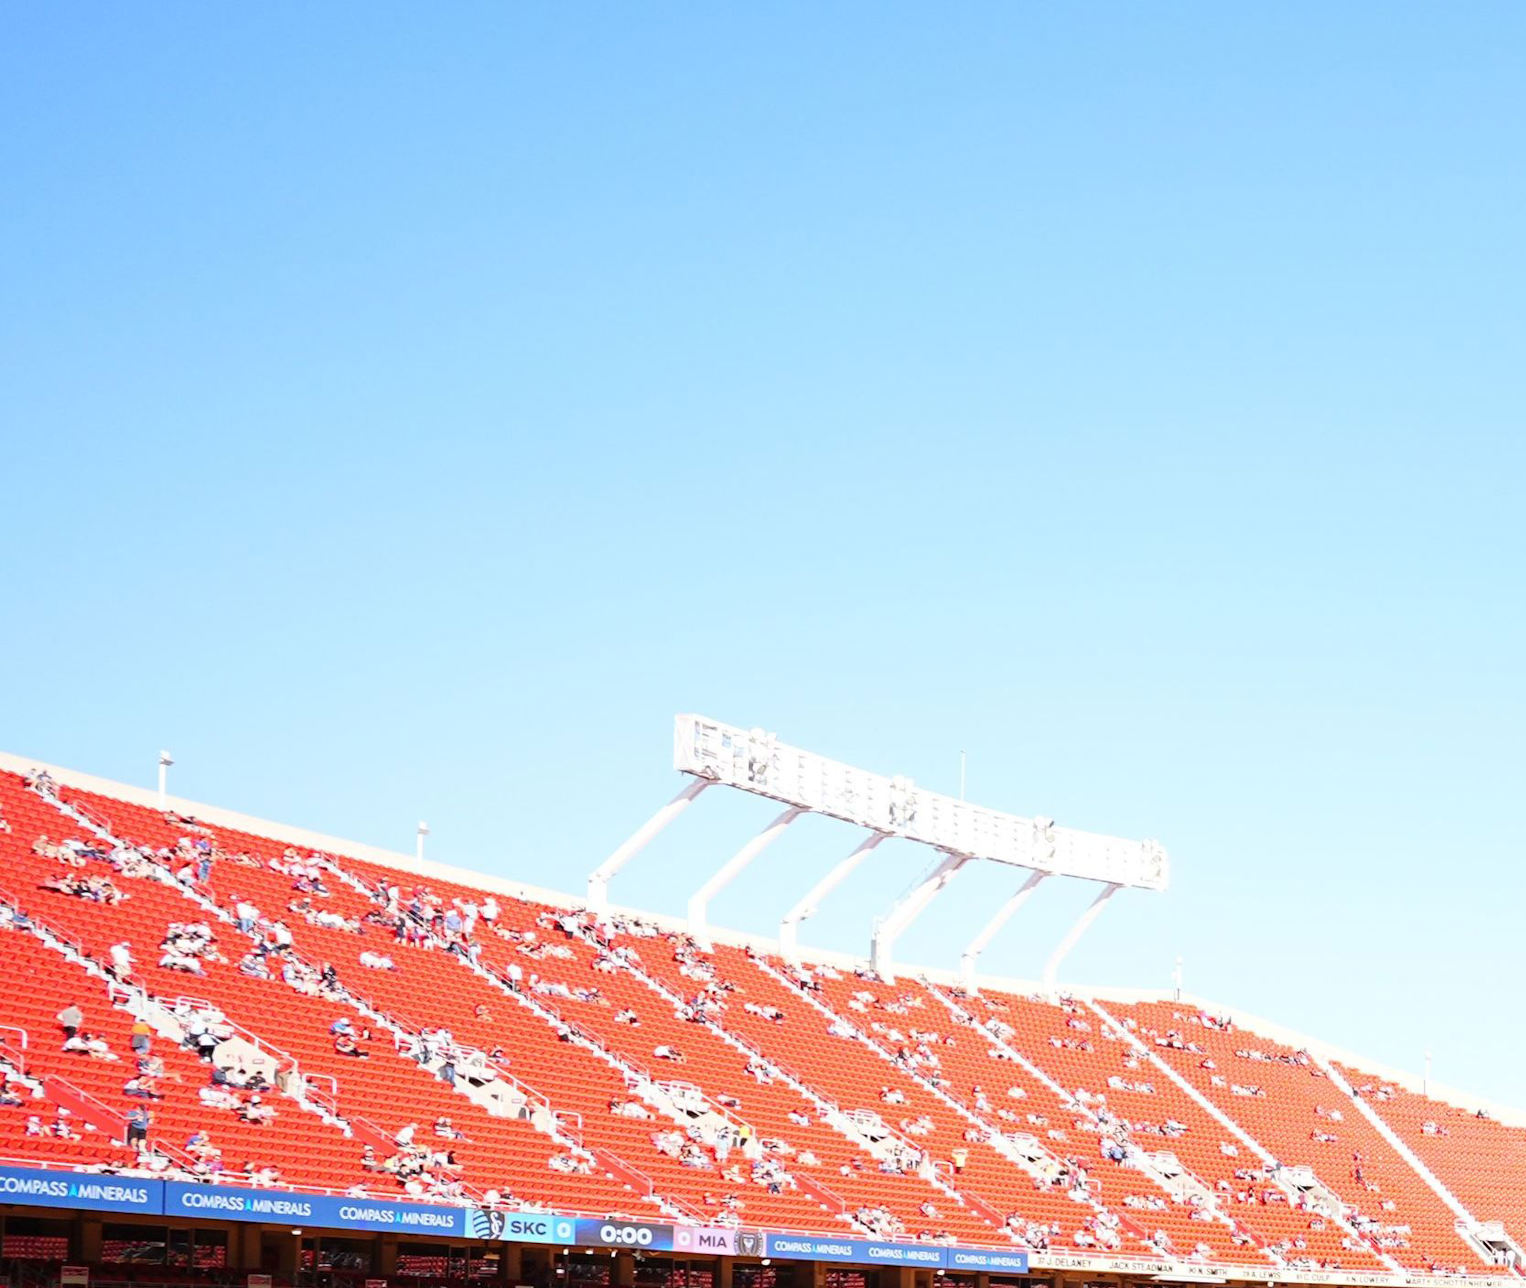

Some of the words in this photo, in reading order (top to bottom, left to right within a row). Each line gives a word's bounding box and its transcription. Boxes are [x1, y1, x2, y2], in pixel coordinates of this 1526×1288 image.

[78, 1184, 147, 1203] MINERALS
[182, 1193, 244, 1210] COMPASS
[253, 1202, 311, 1217] MINERALS
[339, 1206, 394, 1223] COMPASS
[402, 1213, 454, 1228] MINERALS
[510, 1221, 547, 1236] SKC
[557, 1222, 571, 1238] 0
[600, 1225, 653, 1245] 0:00
[678, 1231, 692, 1246] 0
[699, 1235, 727, 1248] MIA
[774, 1241, 812, 1253] COMPASS
[817, 1245, 852, 1256] MINERALS
[1054, 1259, 1092, 1268] DELANEY
[1109, 1261, 1128, 1270] JACK
[1132, 1263, 1173, 1273] STEADMAN
[1206, 1268, 1227, 1276] SMITH
[1260, 1271, 1281, 1280] LEWIS
